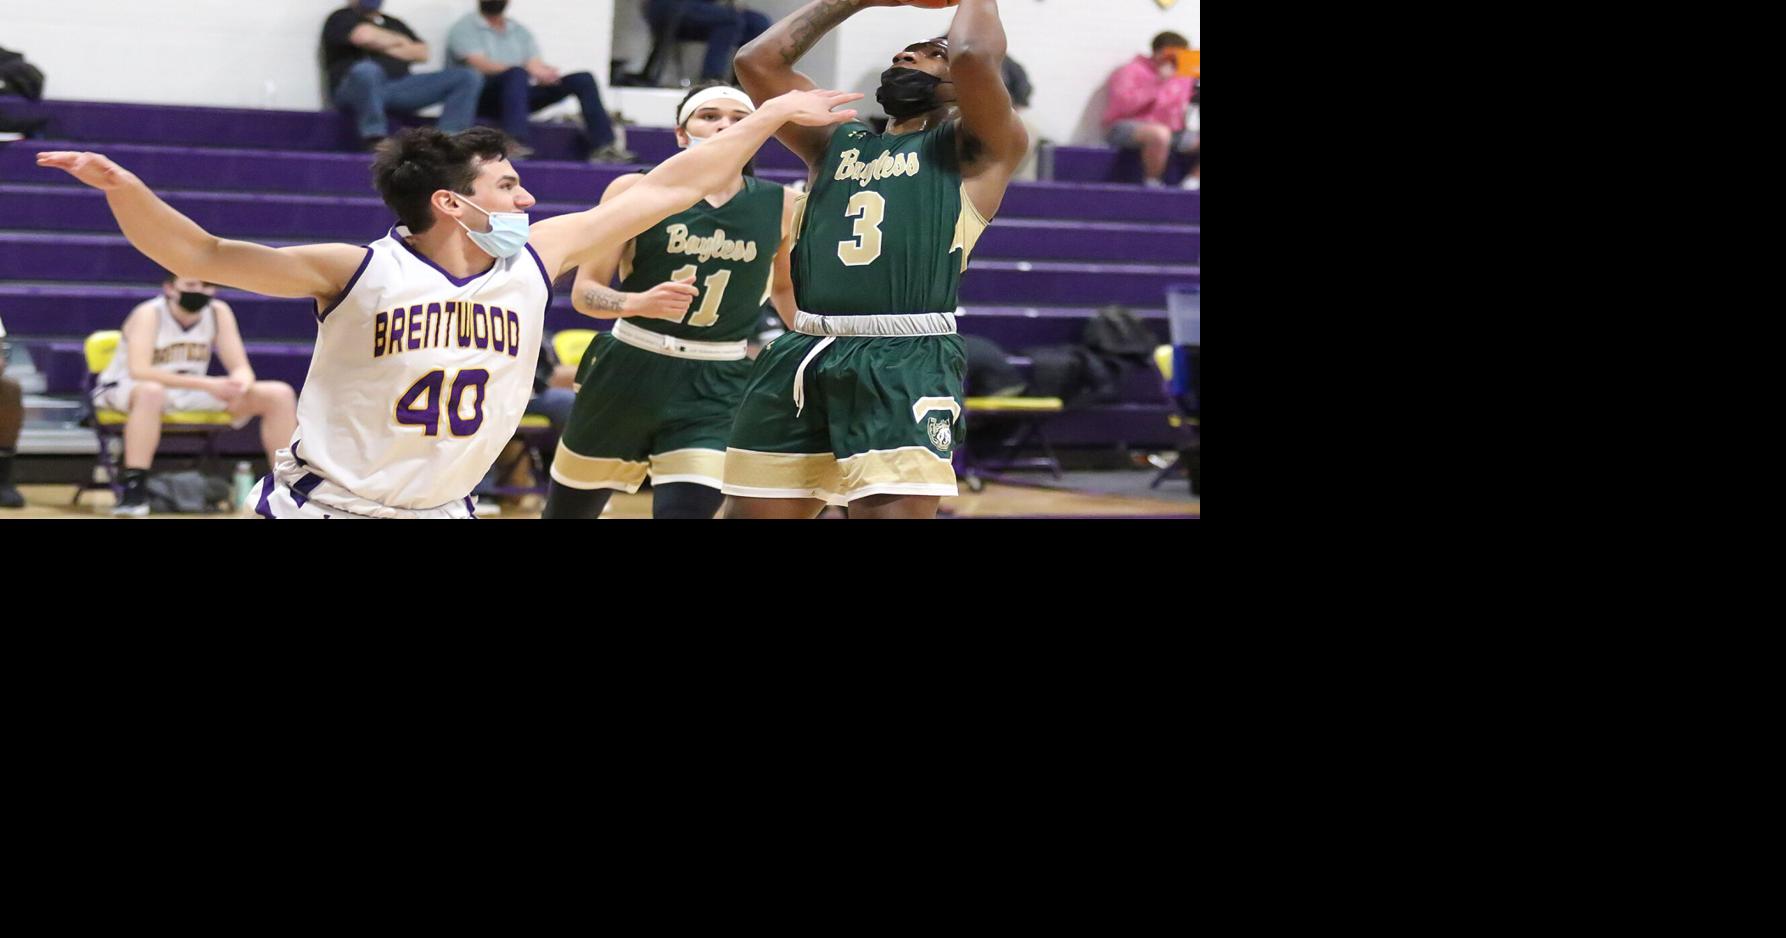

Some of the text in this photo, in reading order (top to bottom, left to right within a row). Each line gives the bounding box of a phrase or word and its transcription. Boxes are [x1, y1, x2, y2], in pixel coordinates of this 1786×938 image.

[834, 148, 920, 187] Bayless
[666, 223, 758, 263] Bayless
[837, 190, 886, 266] 3
[373, 300, 521, 359] BRENTWOOD
[393, 367, 491, 438] 40
